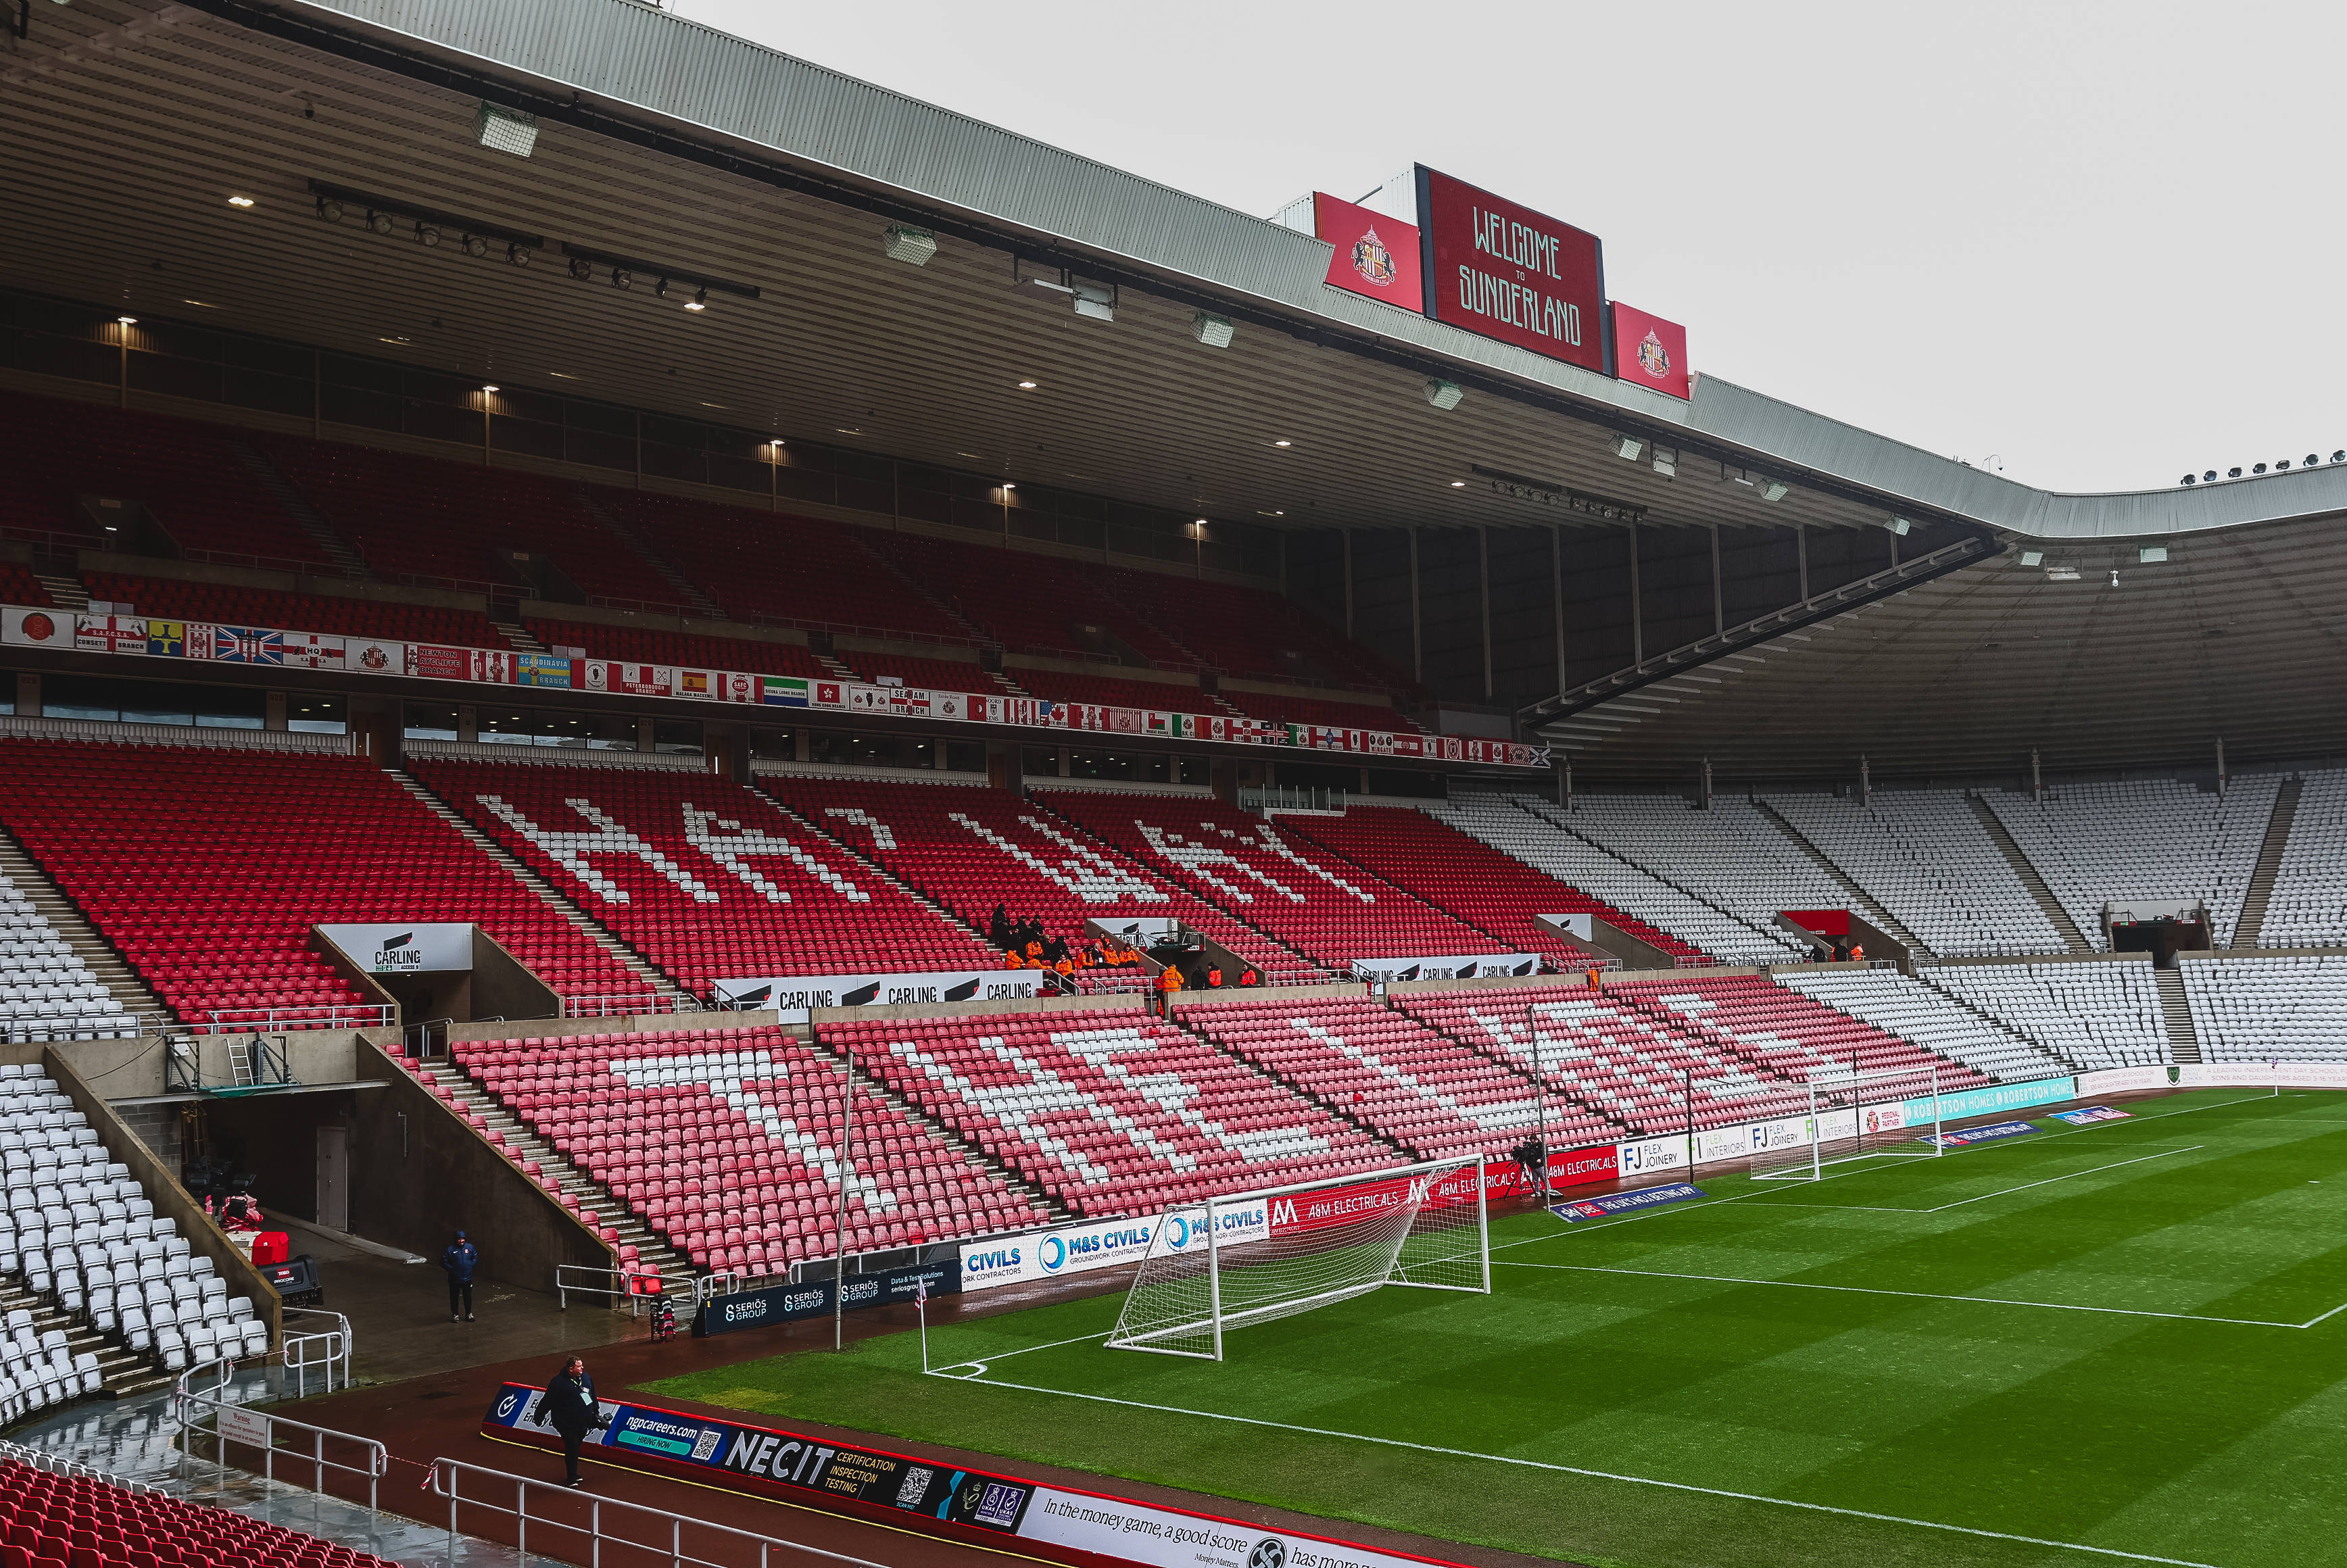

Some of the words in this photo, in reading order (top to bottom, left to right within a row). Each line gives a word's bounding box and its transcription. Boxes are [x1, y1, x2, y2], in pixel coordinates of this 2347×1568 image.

[1474, 206, 1562, 280] WELCOME
[1516, 270, 1525, 281] TO
[1459, 264, 1580, 347] SUNDERLAND
[77, 639, 106, 647] CONSETT
[118, 642, 144, 650] BRANCH
[419, 649, 456, 658] NEWTON
[419, 658, 460, 667] AYCLIFFE
[520, 657, 568, 668] SCANDINAVIA
[420, 666, 456, 675] BRANCH
[539, 677, 568, 685] BRANCH
[626, 683, 664, 691] PETERBOROUGH
[894, 689, 925, 700] SEAHAM
[896, 706, 925, 714] BRANCH
[374, 949, 420, 965] CARLING
[1423, 967, 1453, 981] CARLING
[1482, 965, 1509, 978] CARLING
[888, 986, 937, 1005] CARLING
[987, 982, 1032, 1000] CARLING
[780, 989, 833, 1011] CARLING
[1968, 1093, 1995, 1109] HOMES
[2002, 1085, 2050, 1105] ROBERTSON
[2050, 1081, 2075, 1096] HOMES
[1822, 1116, 1838, 1127] FLEX
[1881, 1110, 1900, 1121] REGIONAL
[1769, 1124, 1785, 1135] FLEX
[1823, 1123, 1858, 1138] INTERIORS
[1882, 1119, 1900, 1128] PARTNER
[1705, 1132, 1722, 1144] FLEX
[1752, 1127, 1769, 1149] FJ
[1770, 1132, 1798, 1147] JOINERY
[1644, 1143, 1662, 1155] FLEX
[1706, 1141, 1745, 1156] INTERIORS
[1624, 1147, 1642, 1171] FJ
[1645, 1154, 1677, 1168] JOINERY
[1548, 1165, 1565, 1178] A&M
[1567, 1155, 1617, 1176] ELECTRICALS
[1438, 1181, 1459, 1196] A&M
[1461, 1172, 1516, 1195] ELERICALS
[1308, 1202, 1330, 1219] A&M
[1334, 1191, 1399, 1215] ELECTRICALS
[1561, 1206, 1584, 1218] sky
[1576, 1204, 1601, 1215] bet
[1597, 1202, 1620, 1210] THE
[1647, 1189, 1681, 1202] BETTING
[1678, 1185, 1697, 1195] APP
[1192, 1215, 1219, 1234] M&S
[1222, 1210, 1263, 1230] CIVILS
[1232, 1226, 1264, 1239] CONTRACTORS
[1069, 1236, 1100, 1255] M&S
[1104, 1227, 1150, 1249] CIVILS
[968, 1248, 1021, 1272] CIVILS
[1070, 1252, 1109, 1265] GROUNDWORK
[1111, 1244, 1151, 1258] CONTRACTORS
[891, 1276, 903, 1285] Data
[920, 1271, 944, 1280] Solutions
[976, 1267, 1021, 1281] CONTRACTORS
[850, 1281, 878, 1292] SERIÖS
[891, 1279, 936, 1294] seriosgroucom
[794, 1290, 823, 1302] SERIÖS
[850, 1290, 878, 1302] GROUP
[736, 1299, 767, 1312] SERIÖS
[794, 1299, 824, 1310] GROUP
[736, 1308, 767, 1321] GROUP
[233, 1412, 251, 1425] Warning
[626, 1414, 697, 1440] ngpcareers.com
[637, 1435, 657, 1447] HIRING
[656, 1440, 673, 1450] NOW
[725, 1430, 835, 1485] NECIT
[837, 1452, 896, 1473] CERTIFICATION
[829, 1464, 878, 1484] INSPECTION
[824, 1477, 858, 1494] TESTING
[896, 1501, 907, 1509] SCAN
[981, 1504, 996, 1513] UKAS
[999, 1509, 1013, 1517] UKAS
[1043, 1498, 1057, 1514] In
[1059, 1501, 1080, 1519] the
[1080, 1507, 1125, 1531] money
[1123, 1517, 1161, 1539] game,
[1165, 1525, 1174, 1538] a
[1172, 1529, 1210, 1546] good
[1209, 1534, 1248, 1554] score
[1290, 1546, 1318, 1567] has
[1194, 1552, 1216, 1565] Money
